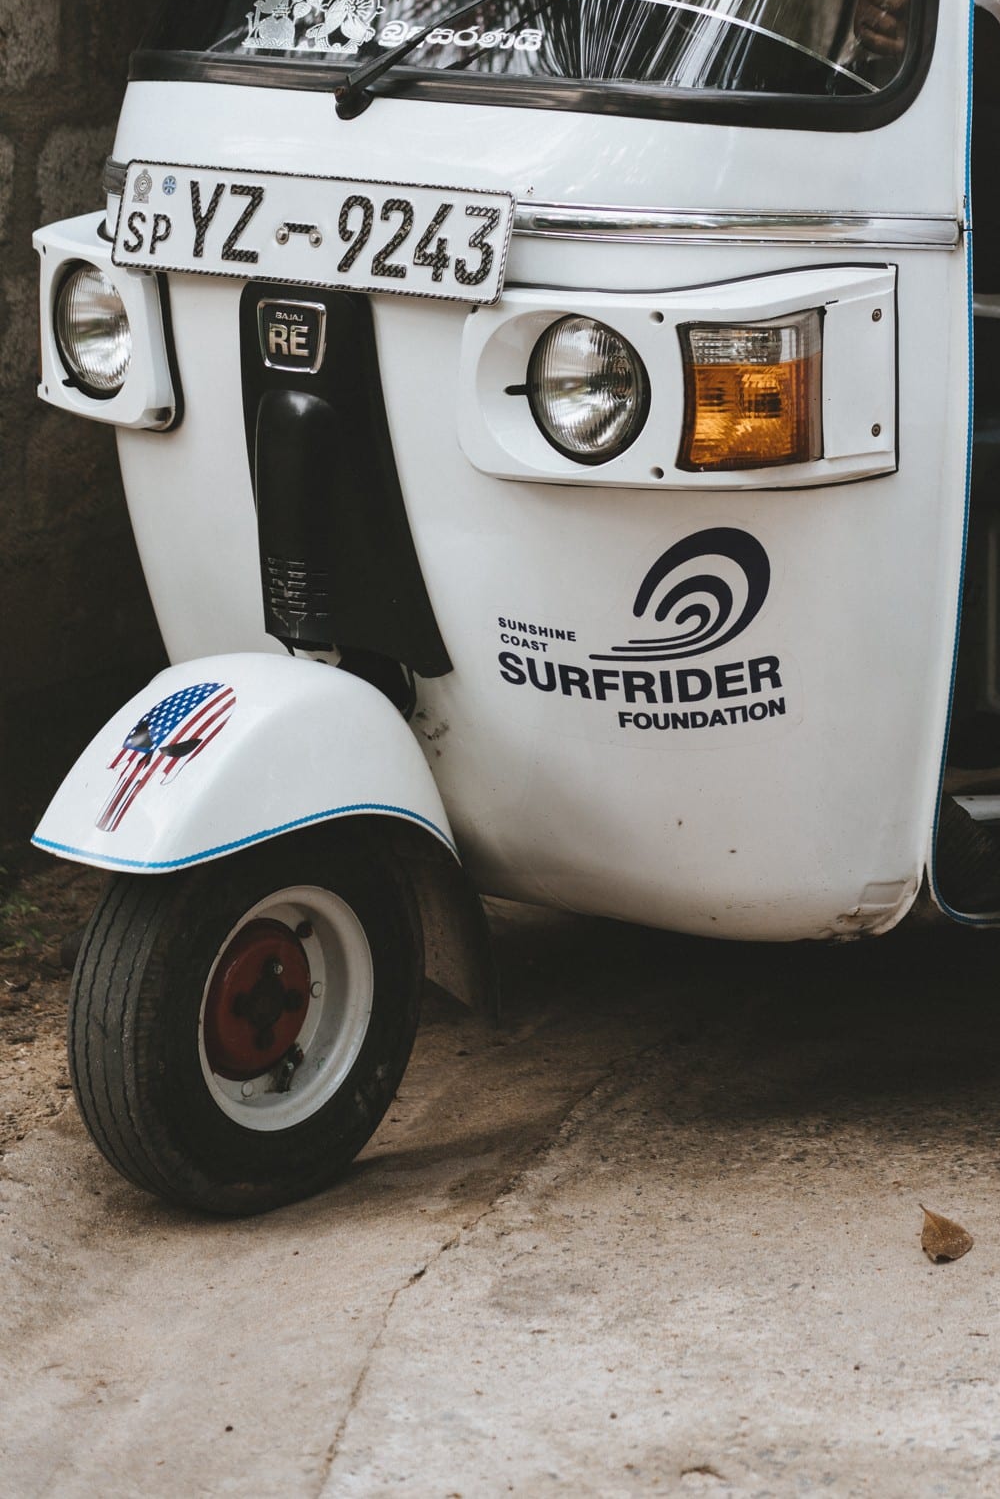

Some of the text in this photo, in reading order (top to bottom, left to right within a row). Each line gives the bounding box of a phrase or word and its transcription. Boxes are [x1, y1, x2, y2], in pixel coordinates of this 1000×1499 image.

[123, 210, 172, 255] SP
[275, 311, 304, 322] BAJAJ
[268, 322, 310, 357] RE
[498, 616, 577, 642] SUNSHINE
[500, 633, 549, 652] COAST
[498, 650, 783, 704] SURFRIDER
[618, 697, 786, 730] FOUNDATION
